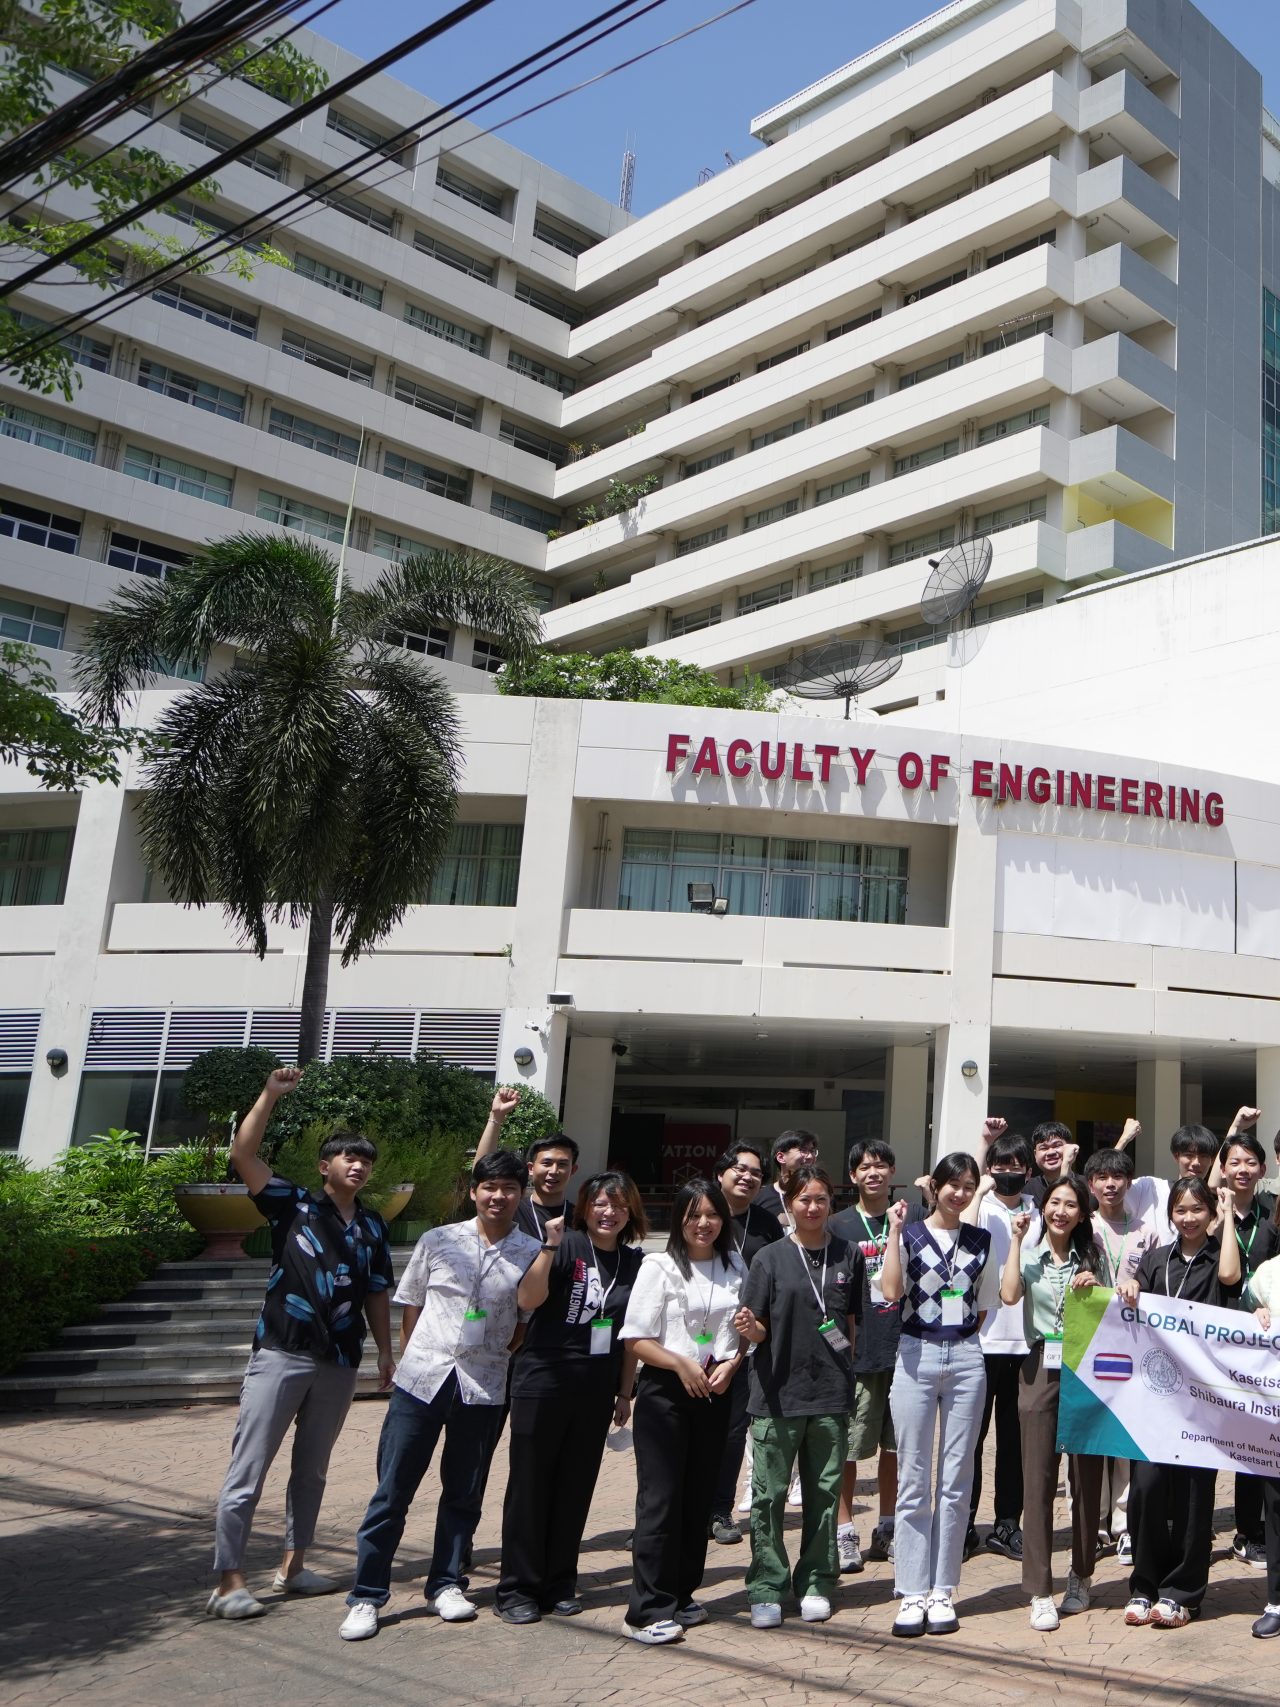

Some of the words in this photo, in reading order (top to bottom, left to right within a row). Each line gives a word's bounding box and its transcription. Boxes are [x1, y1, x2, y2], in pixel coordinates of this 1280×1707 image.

[665, 733, 877, 786] FACULTY
[897, 750, 951, 793] OF
[971, 758, 1226, 828] ENGINEERING
[565, 1281, 585, 1324] DONGTAN
[1120, 1306, 1200, 1337] GLOBAL
[1189, 1385, 1246, 1412] Shibaura
[1181, 1430, 1235, 1448] Department
[1236, 1441, 1246, 1450] of
[1229, 1451, 1273, 1468] Kasetsart
